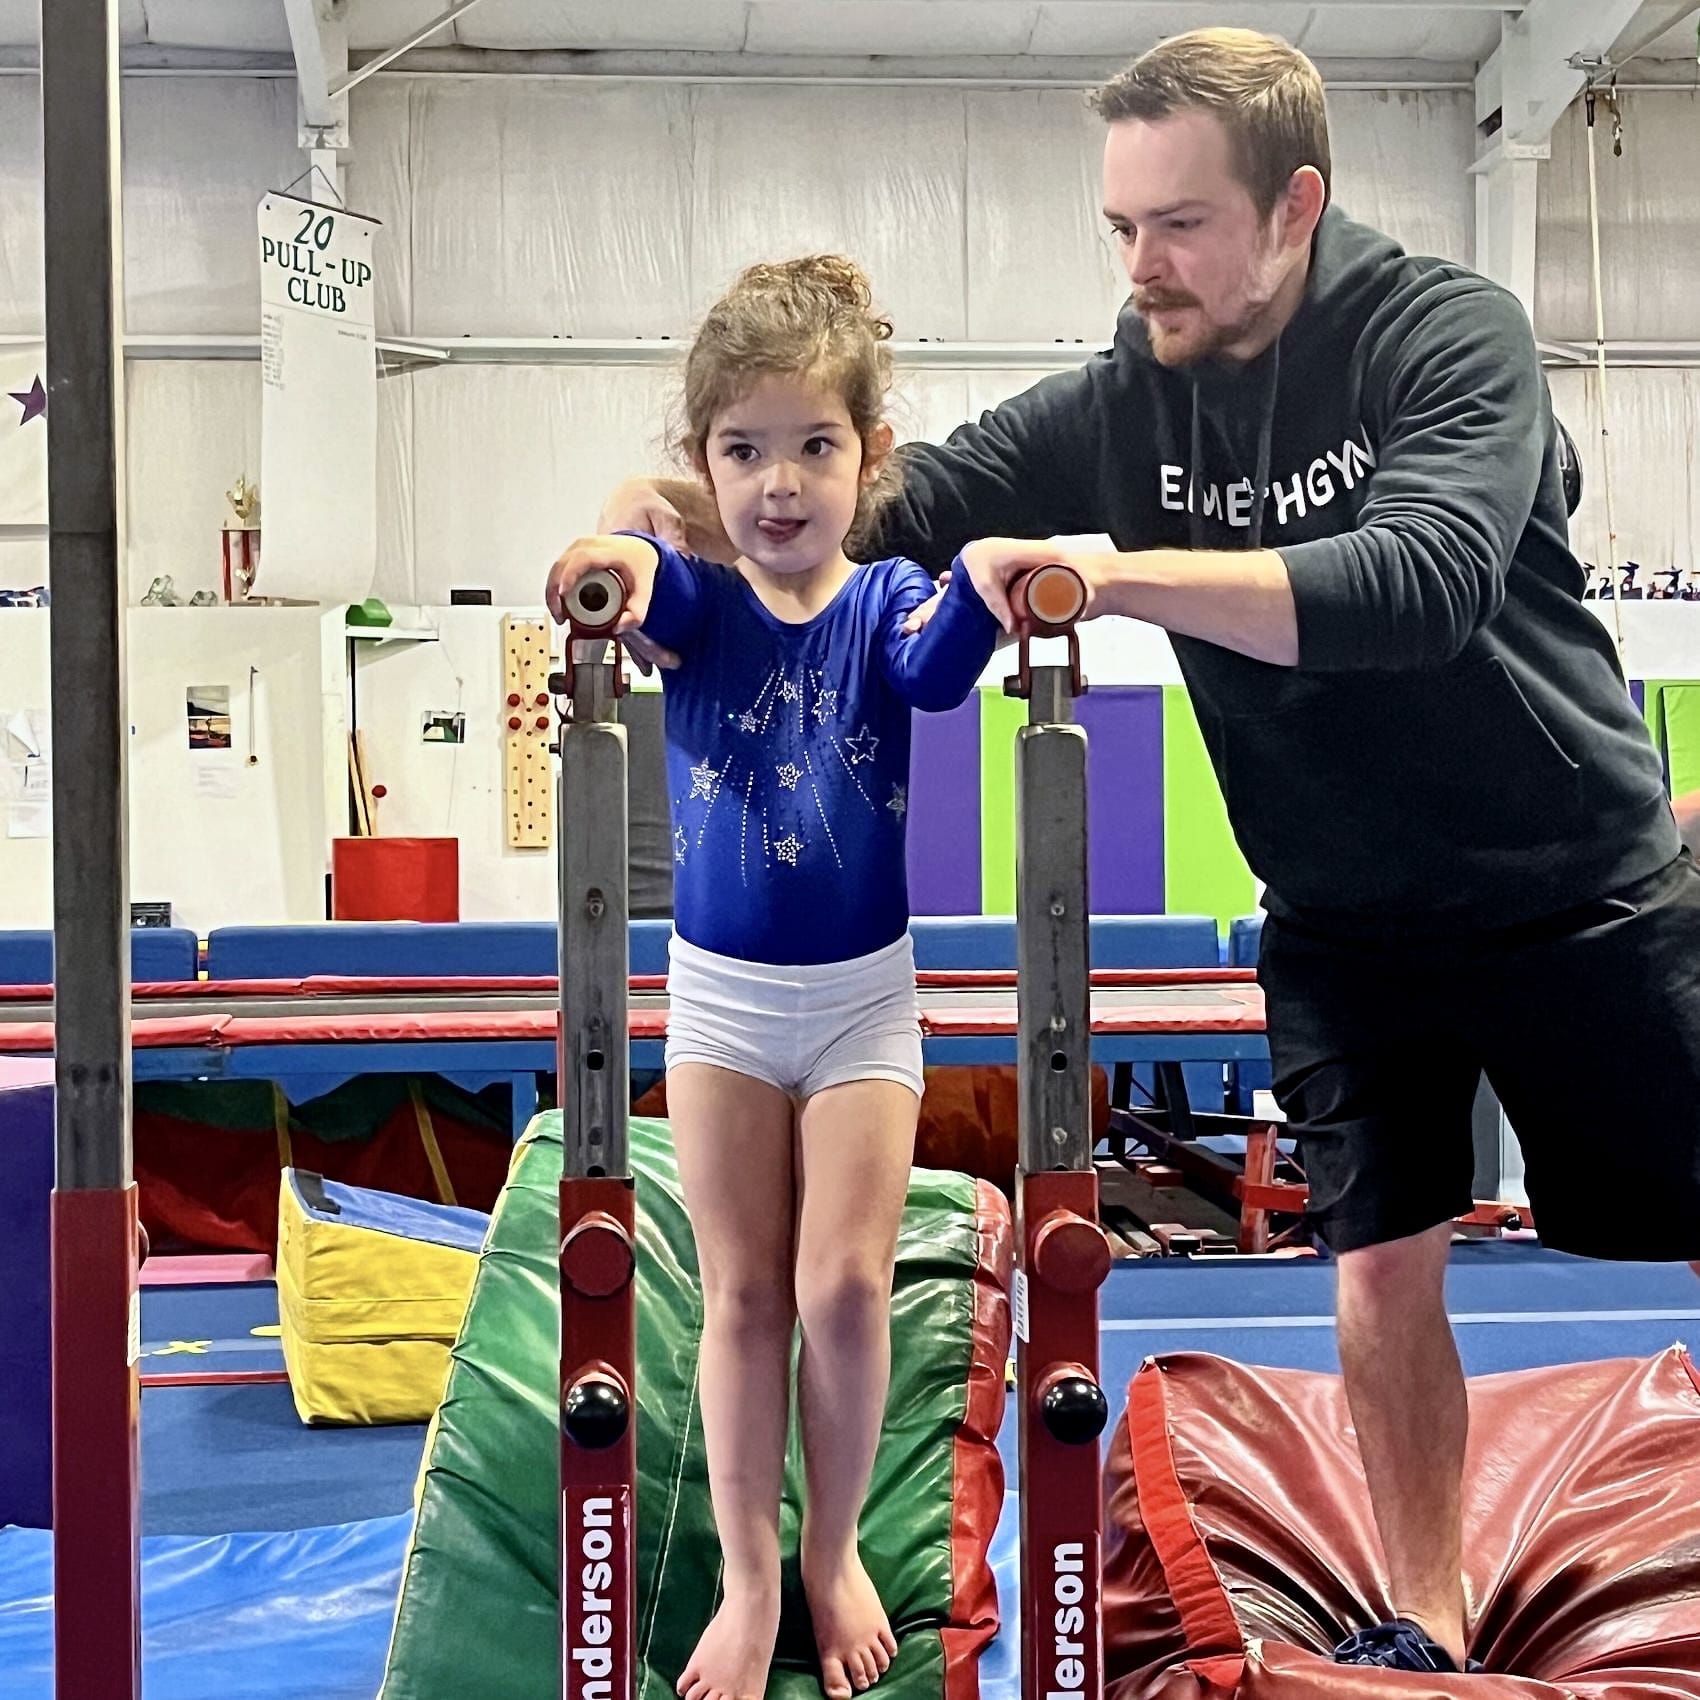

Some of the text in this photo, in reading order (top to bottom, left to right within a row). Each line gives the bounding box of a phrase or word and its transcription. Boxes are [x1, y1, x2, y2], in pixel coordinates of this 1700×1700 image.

[294, 209, 334, 250] 20
[261, 236, 372, 287] PULL-UP
[287, 276, 346, 312] CLUB
[1160, 423, 1377, 527] EMEHGYM
[1046, 1543, 1085, 1700] erson
